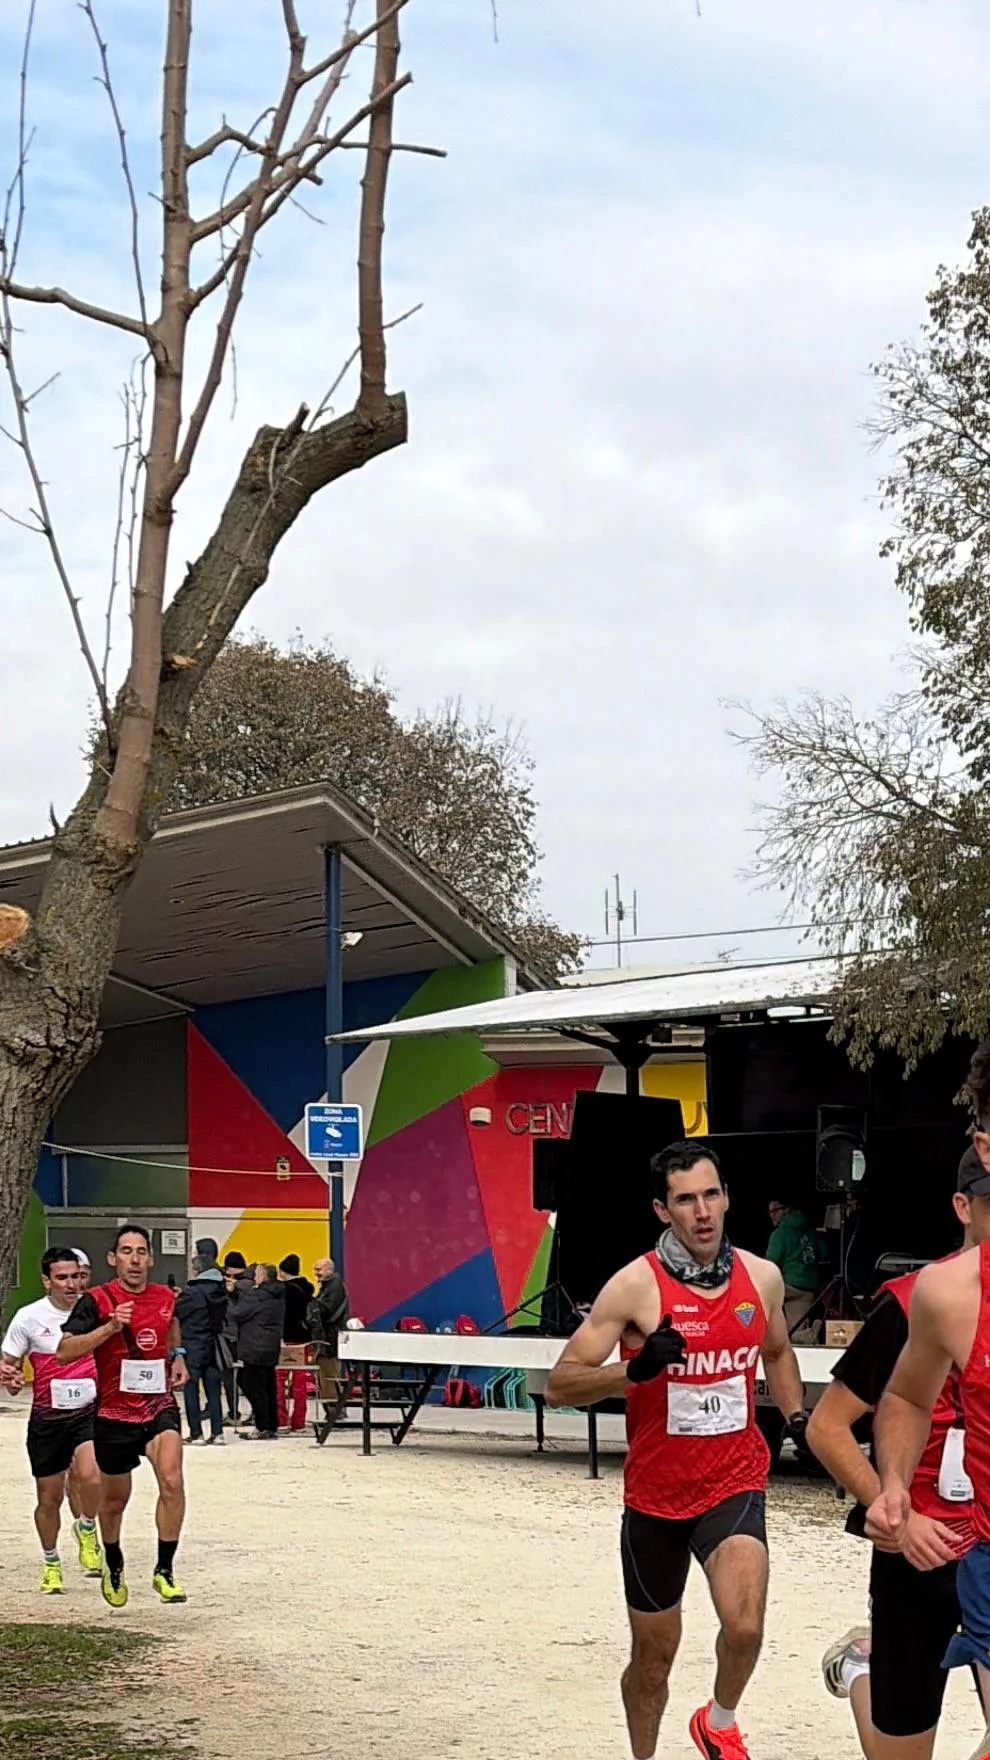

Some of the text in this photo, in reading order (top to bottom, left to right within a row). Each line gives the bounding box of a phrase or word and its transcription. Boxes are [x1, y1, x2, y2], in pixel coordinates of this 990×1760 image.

[505, 1102, 573, 1134] CEN
[139, 1370, 153, 1380] 50
[67, 1388, 81, 1398] 16
[699, 1395, 721, 1414] 40
